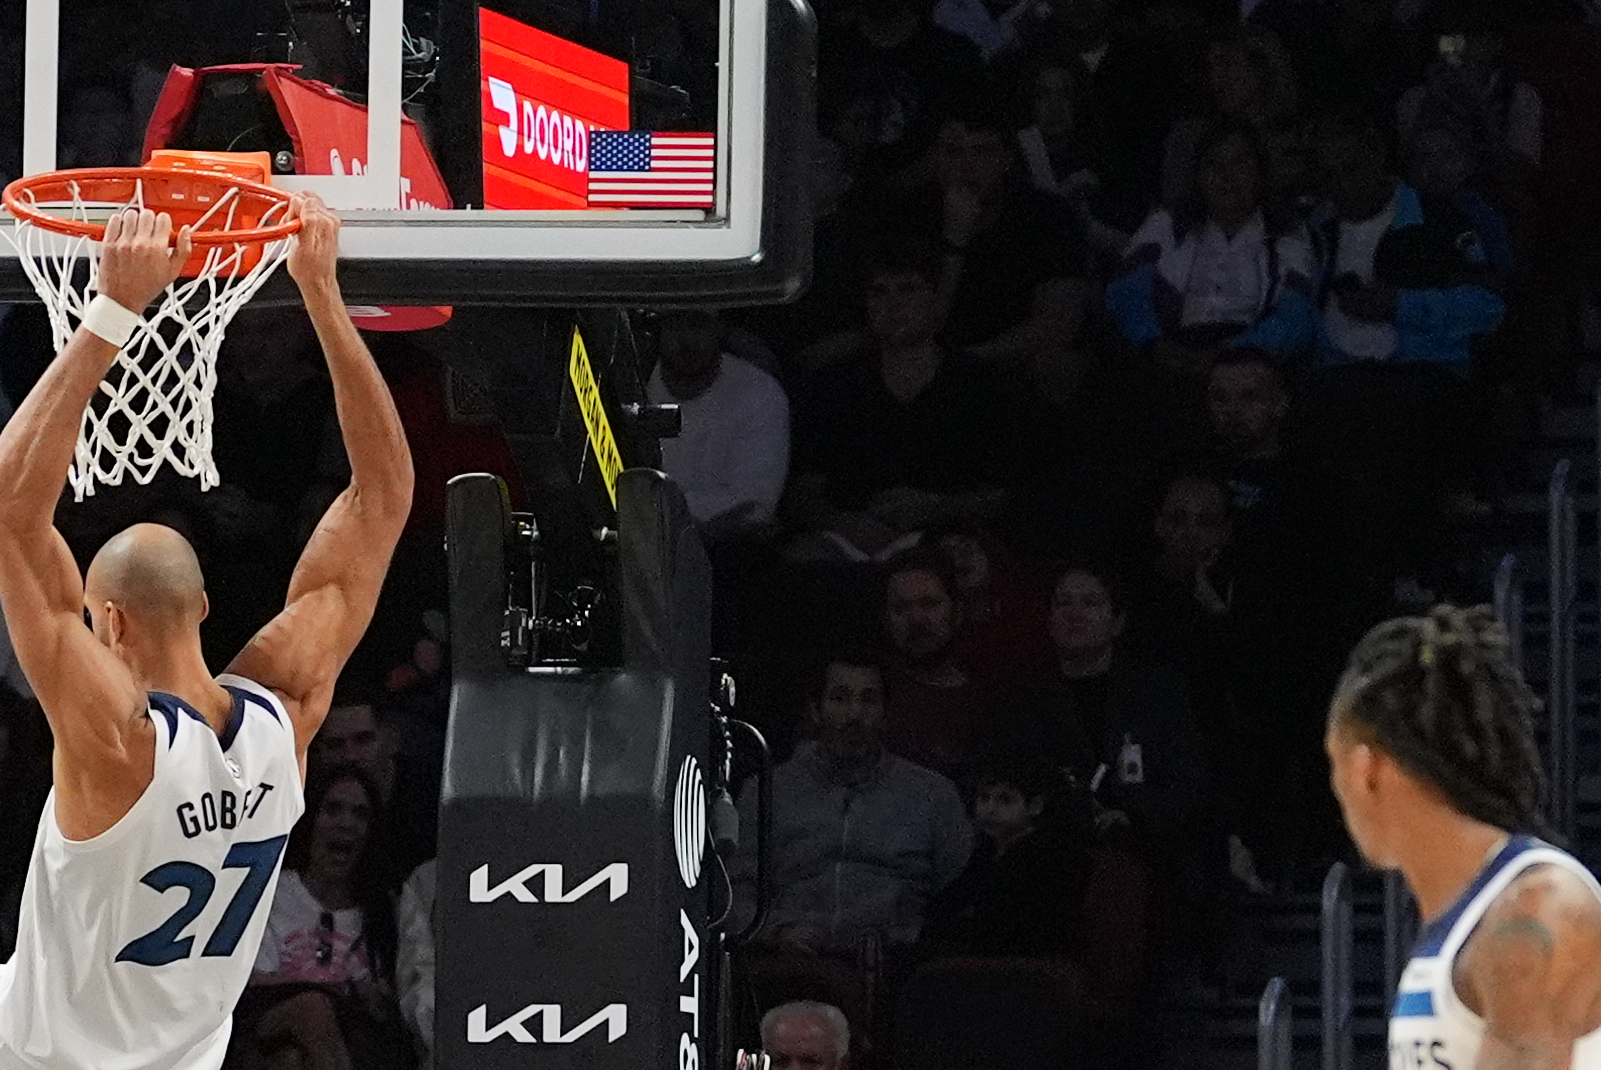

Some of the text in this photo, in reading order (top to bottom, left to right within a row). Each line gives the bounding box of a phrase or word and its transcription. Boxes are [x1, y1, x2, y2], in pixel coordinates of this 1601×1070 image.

[523, 100, 606, 172] DOORD
[114, 834, 288, 966] 27
[470, 863, 628, 902] KIA
[467, 1003, 627, 1043] KIA
